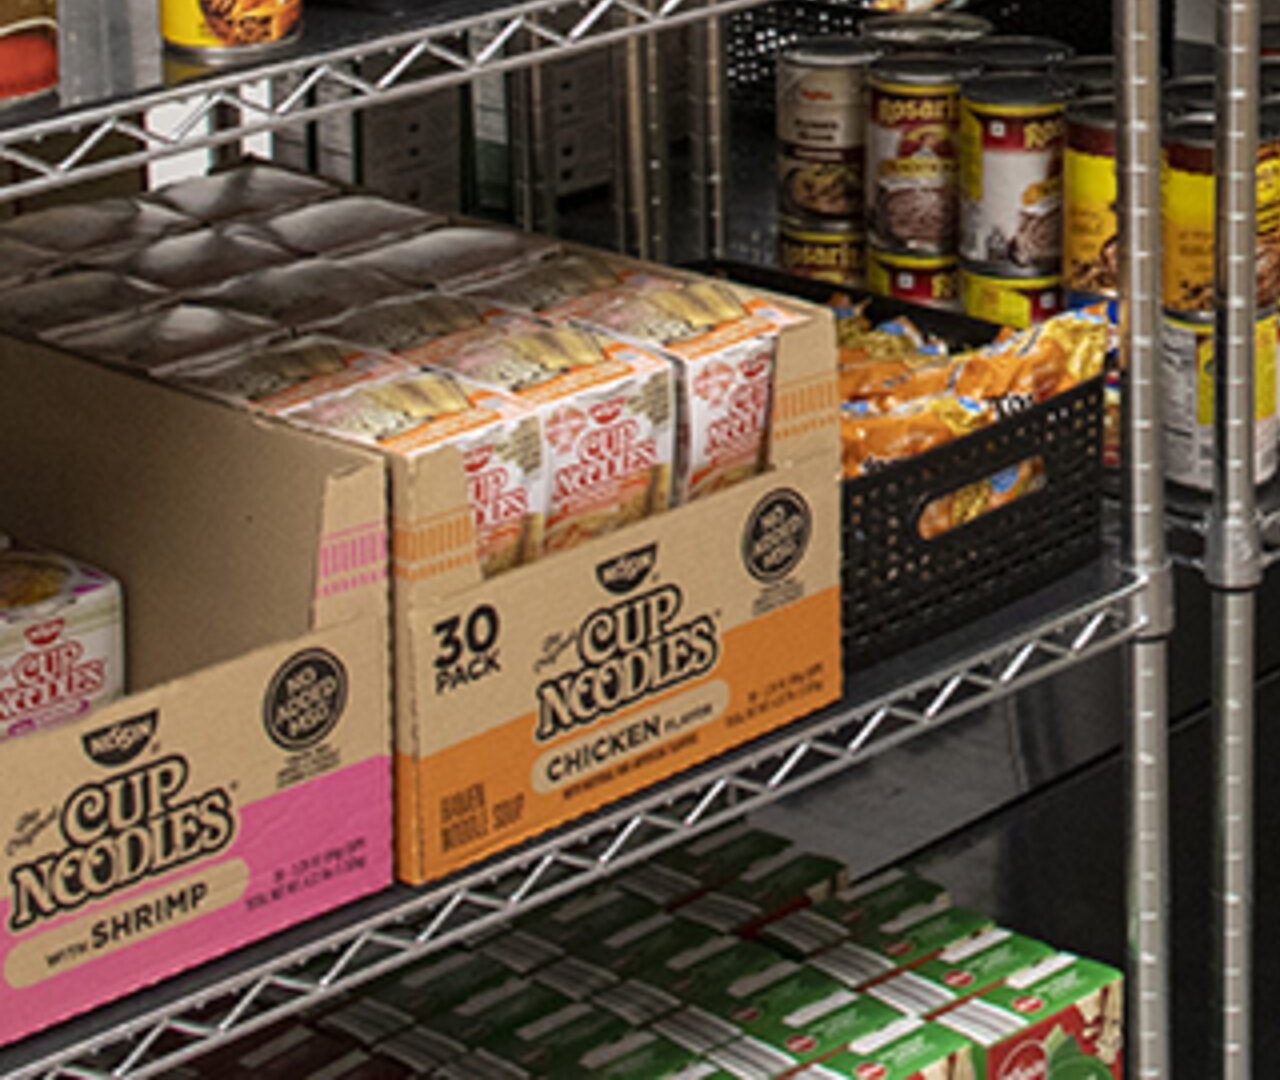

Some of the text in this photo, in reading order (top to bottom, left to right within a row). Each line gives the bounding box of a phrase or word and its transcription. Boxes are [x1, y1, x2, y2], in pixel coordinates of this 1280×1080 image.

[14, 641, 84, 689] CUP
[433, 604, 499, 670] 30
[579, 583, 682, 666] CUP
[435, 653, 500, 694] PACK
[535, 614, 721, 743] NOODLES
[546, 716, 662, 783] CHICKEN
[62, 754, 190, 848] CUP
[9, 787, 237, 931] NOODLES
[45, 883, 209, 968] WITH SHRIMP
